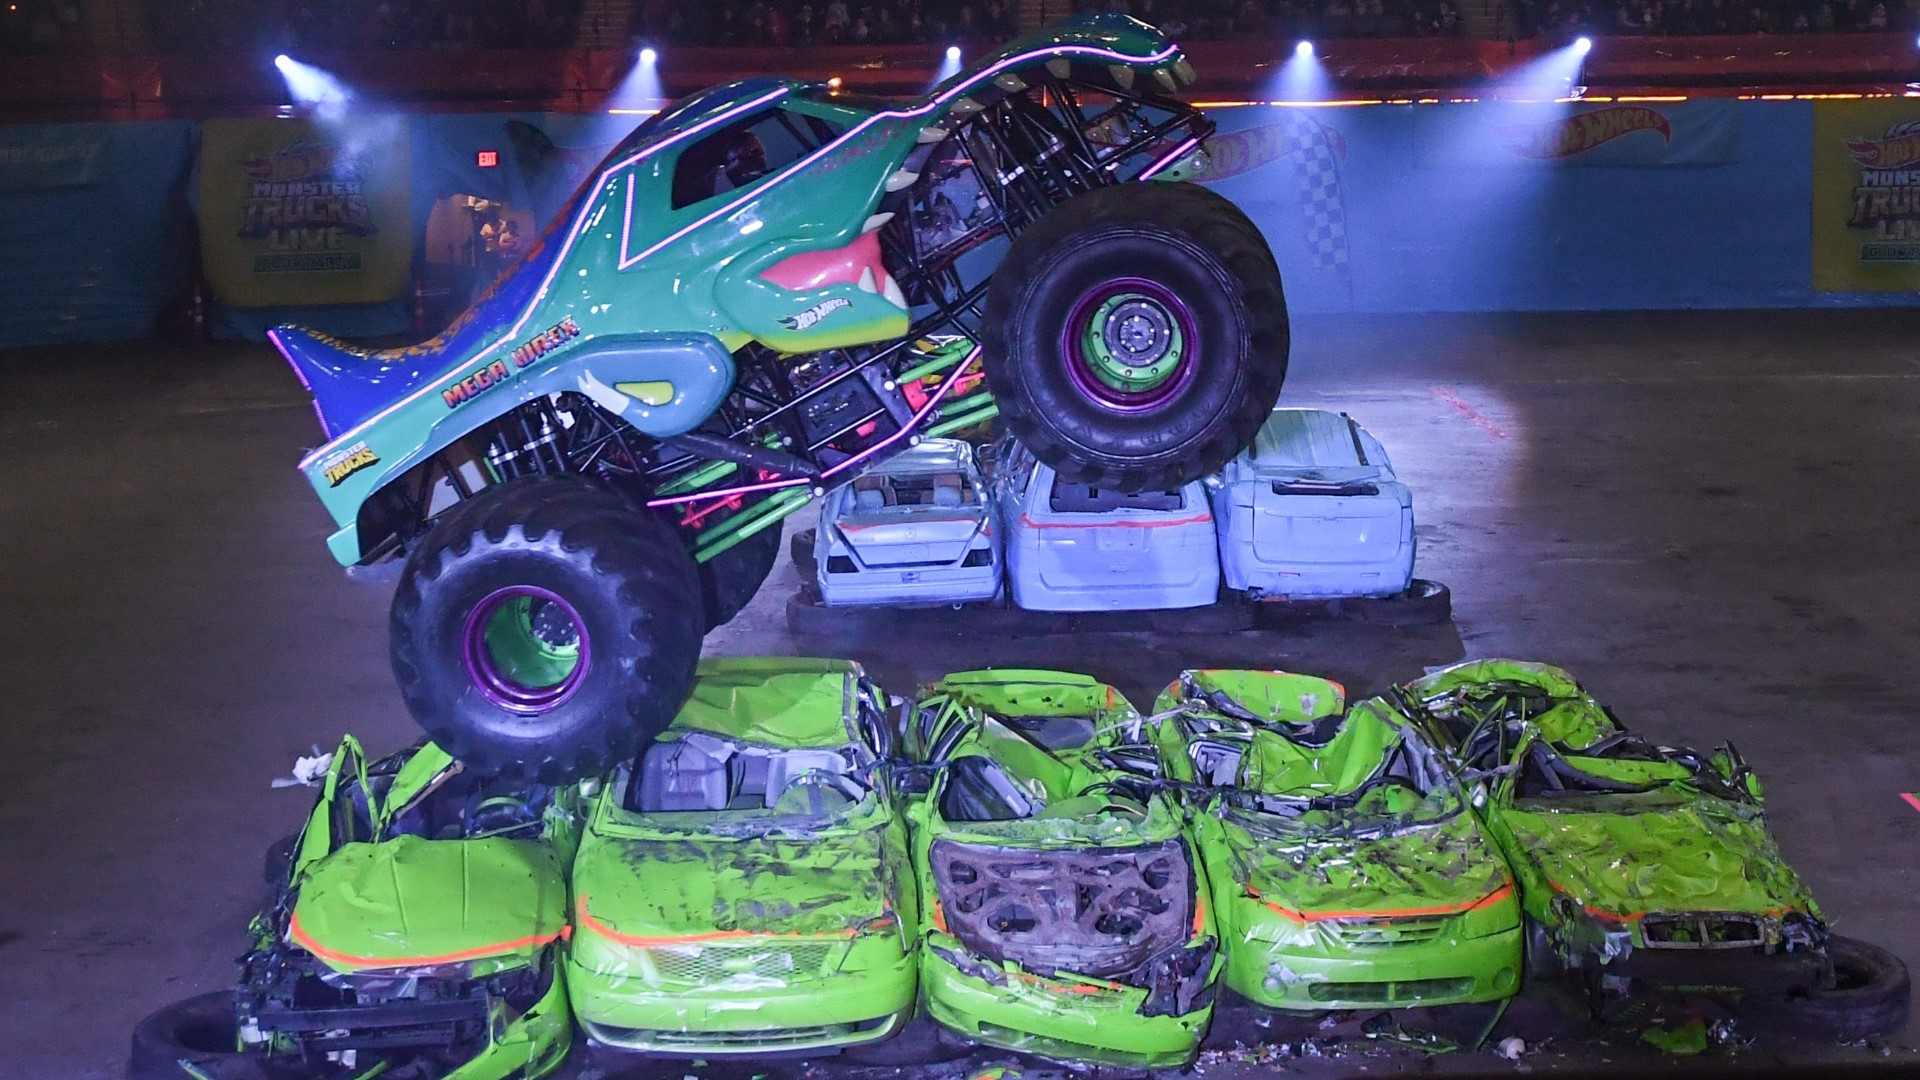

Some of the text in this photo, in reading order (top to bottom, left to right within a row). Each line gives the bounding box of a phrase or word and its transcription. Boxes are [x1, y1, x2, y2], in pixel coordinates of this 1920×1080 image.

[478, 152, 497, 166] EXIT
[253, 182, 361, 196] MONSTER
[244, 196, 370, 230] TRUCKS
[269, 227, 345, 250] LIVE
[441, 359, 510, 409] MEGA
[324, 447, 381, 488] TRUCKS
